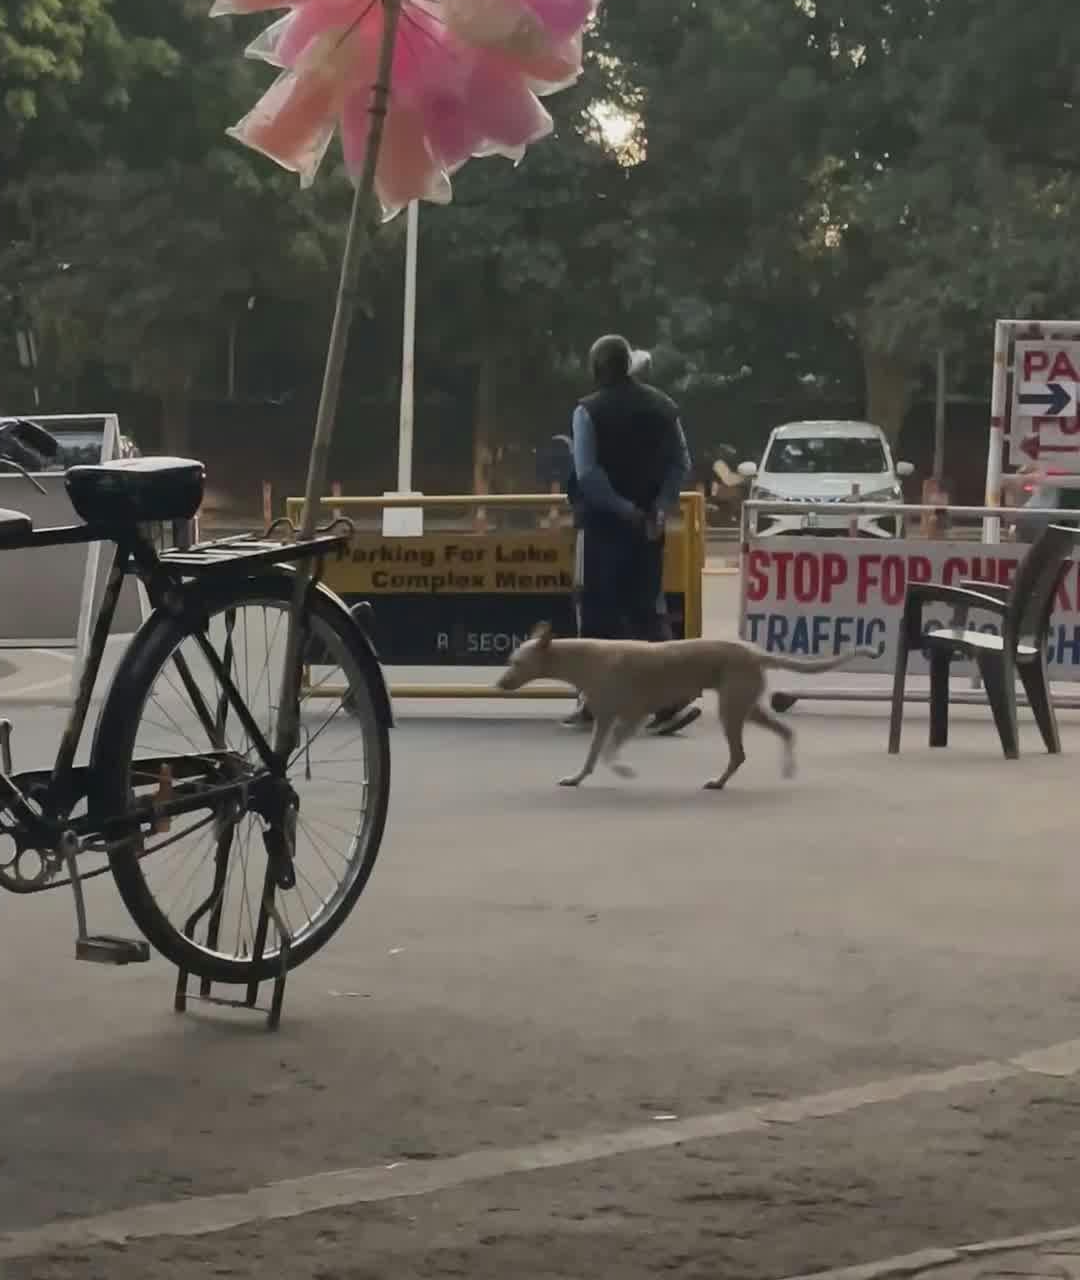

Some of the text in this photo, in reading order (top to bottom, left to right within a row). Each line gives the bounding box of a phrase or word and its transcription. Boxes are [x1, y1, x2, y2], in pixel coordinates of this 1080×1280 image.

[444, 545, 486, 563] For
[495, 543, 558, 563] Lake
[371, 570, 485, 592] Complex
[746, 550, 848, 604] STOP
[746, 613, 886, 659] TRAFFIC
